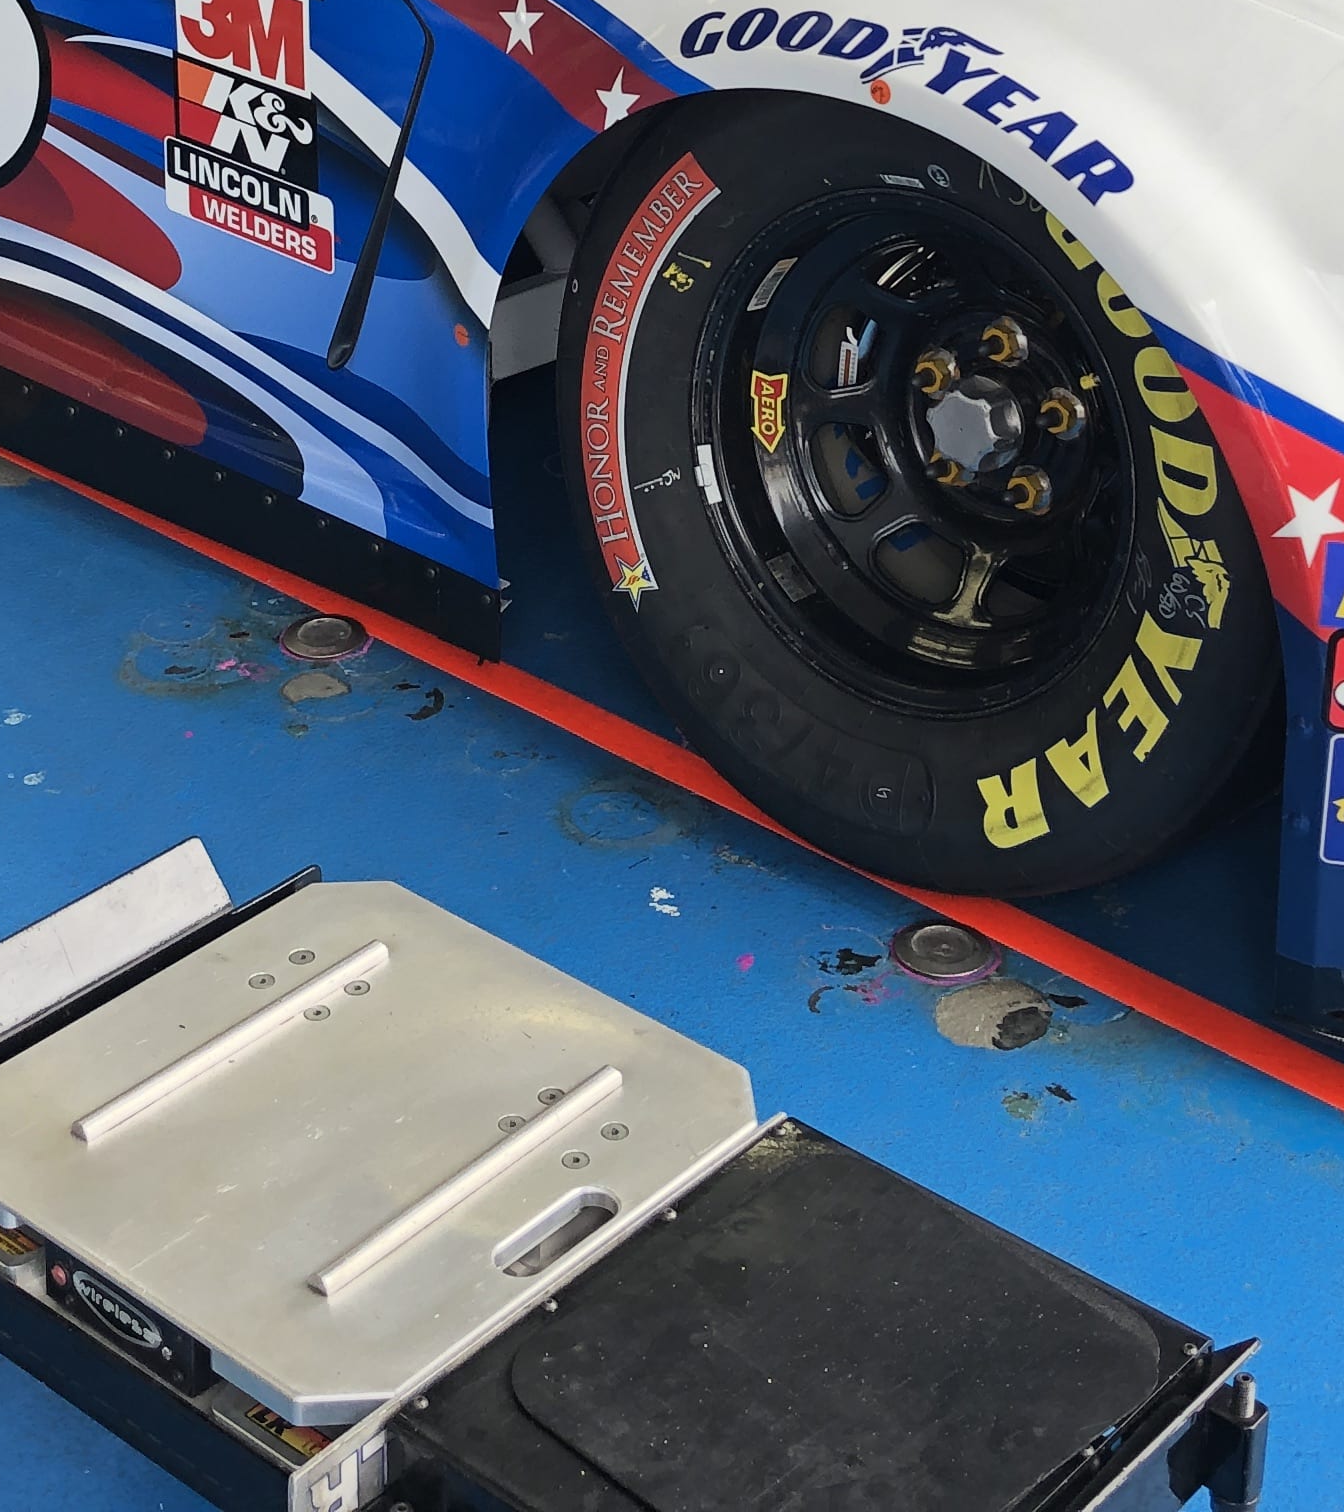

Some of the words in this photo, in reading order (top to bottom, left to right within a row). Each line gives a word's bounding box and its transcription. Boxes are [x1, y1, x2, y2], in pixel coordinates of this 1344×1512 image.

[201, 71, 313, 173] K&N
[679, 6, 1136, 207] GOODYEAR
[173, 146, 302, 224] LINCOLN
[202, 194, 317, 261] WELDERS
[591, 169, 704, 345] REMEMBER
[593, 345, 609, 394] AND
[758, 382, 778, 438] AERO
[585, 397, 630, 547] HONOR
